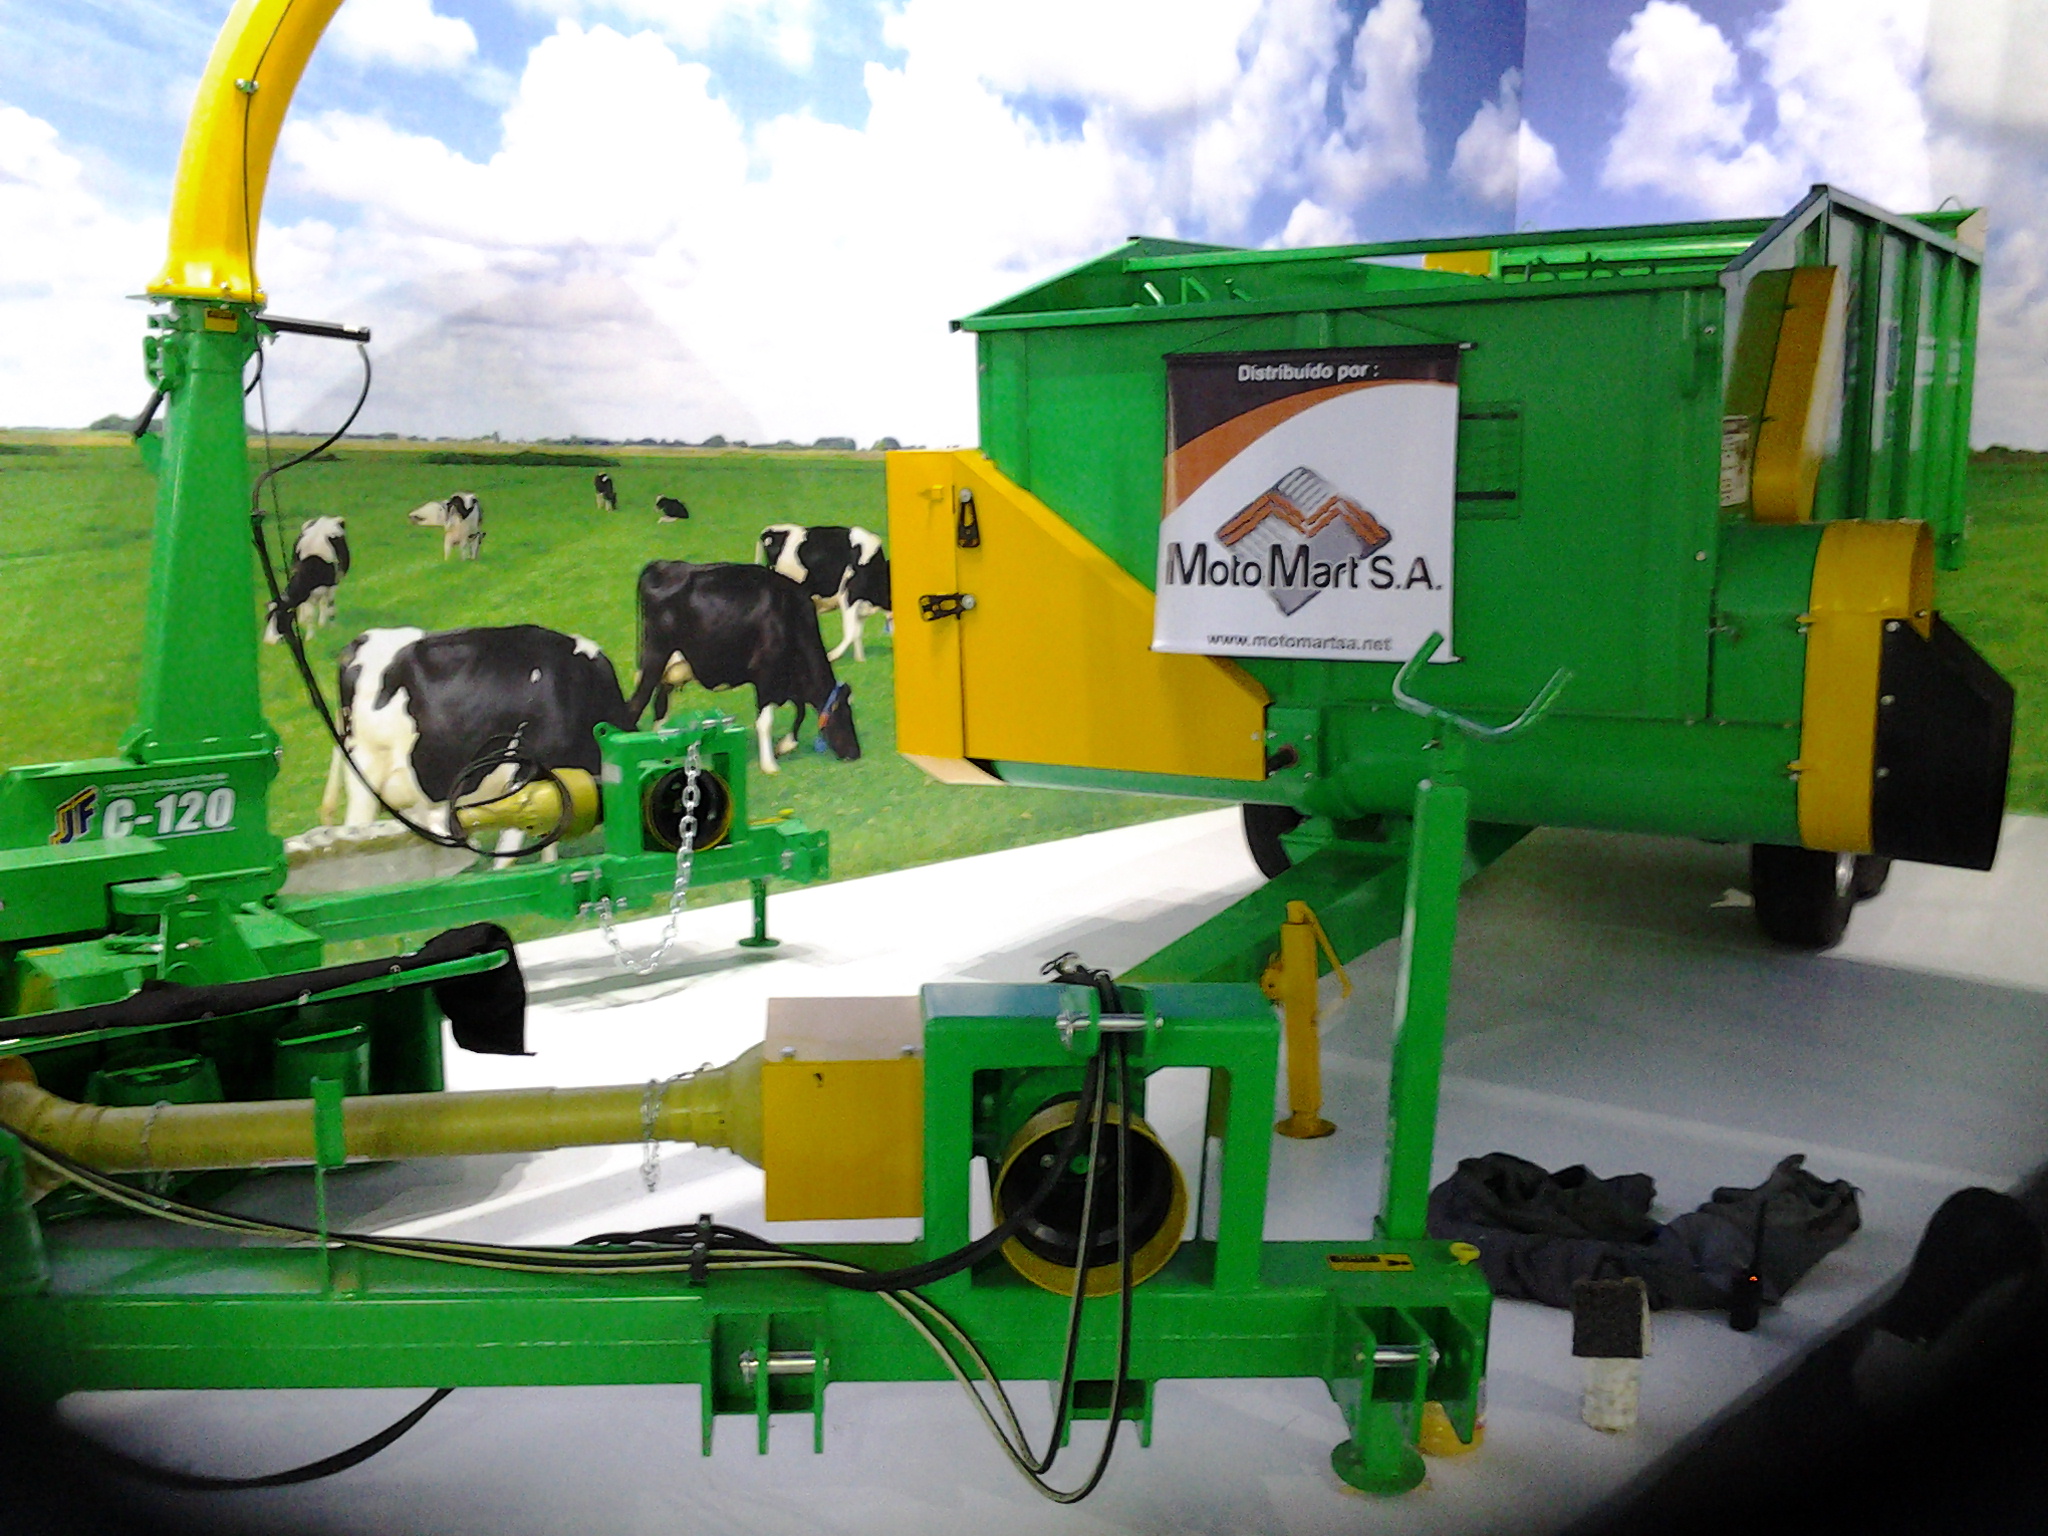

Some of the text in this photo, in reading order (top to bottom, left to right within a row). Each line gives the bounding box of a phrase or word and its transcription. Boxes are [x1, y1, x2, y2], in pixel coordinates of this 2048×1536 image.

[1368, 556, 1443, 590] S.A.
[1207, 634, 1392, 650] www.motomartsa.net
[103, 787, 235, 838] C-120
